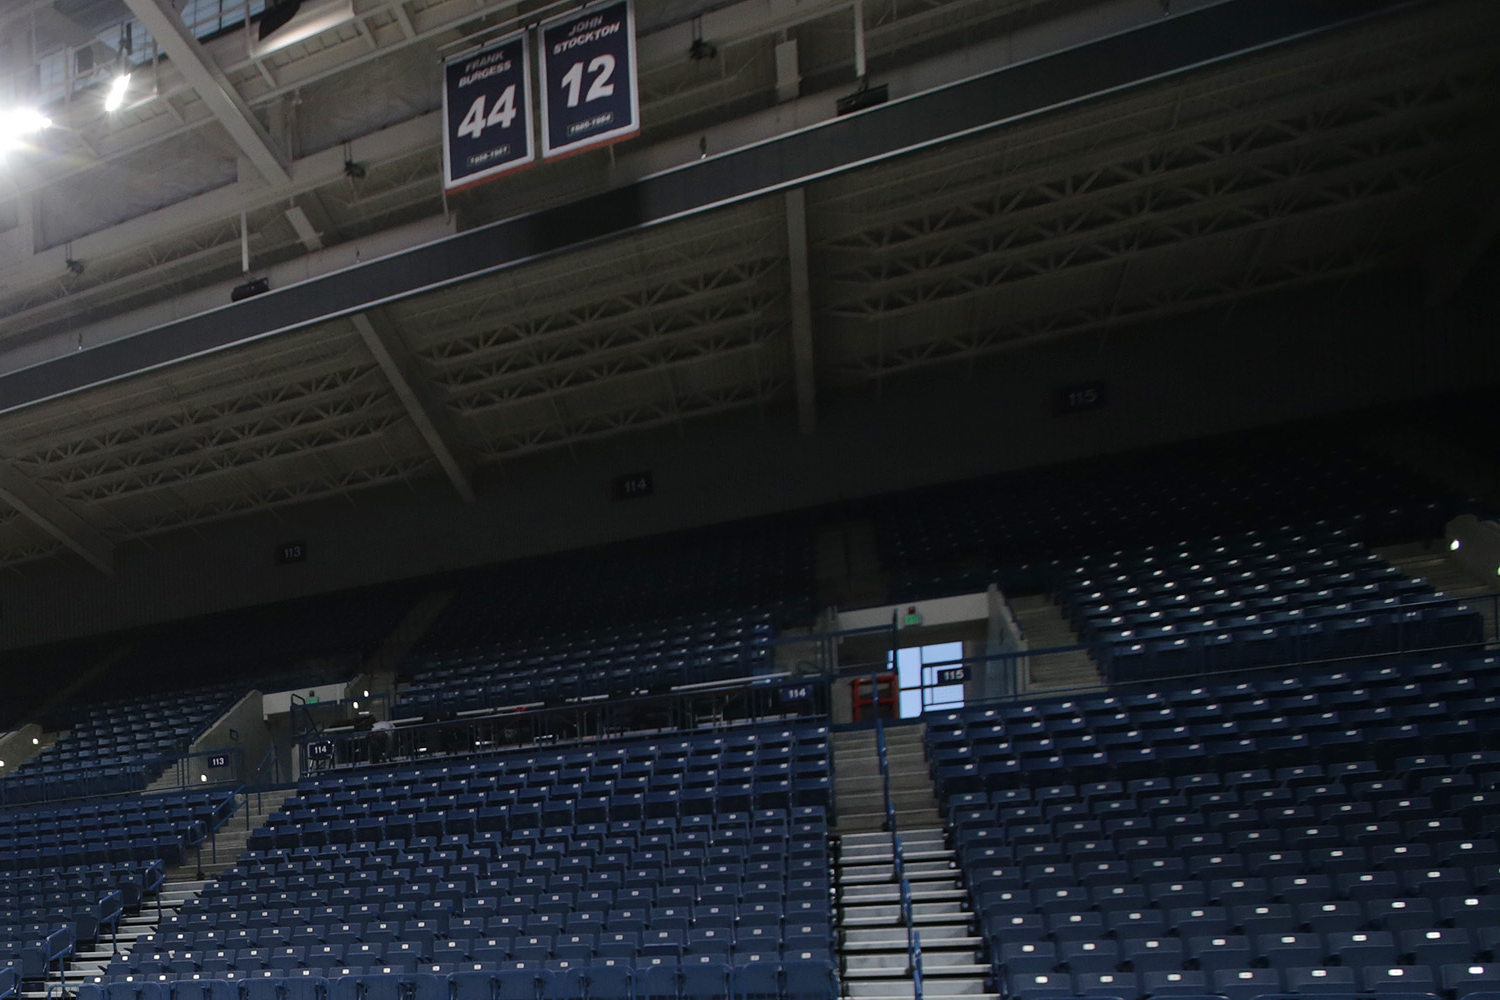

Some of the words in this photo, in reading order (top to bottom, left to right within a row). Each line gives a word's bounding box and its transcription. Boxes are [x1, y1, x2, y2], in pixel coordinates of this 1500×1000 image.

[568, 15, 603, 37] JOHN
[553, 21, 621, 55] STOCKTON
[465, 51, 504, 73] FRANK
[458, 59, 512, 88] BURGESS
[561, 53, 616, 108] 12
[457, 83, 517, 139] 44
[1068, 388, 1098, 406] 115
[625, 478, 648, 493] 114
[284, 545, 301, 559] 113
[944, 668, 965, 680] 115
[789, 687, 807, 699] 114
[314, 744, 327, 754] 114
[212, 757, 225, 766] 113
